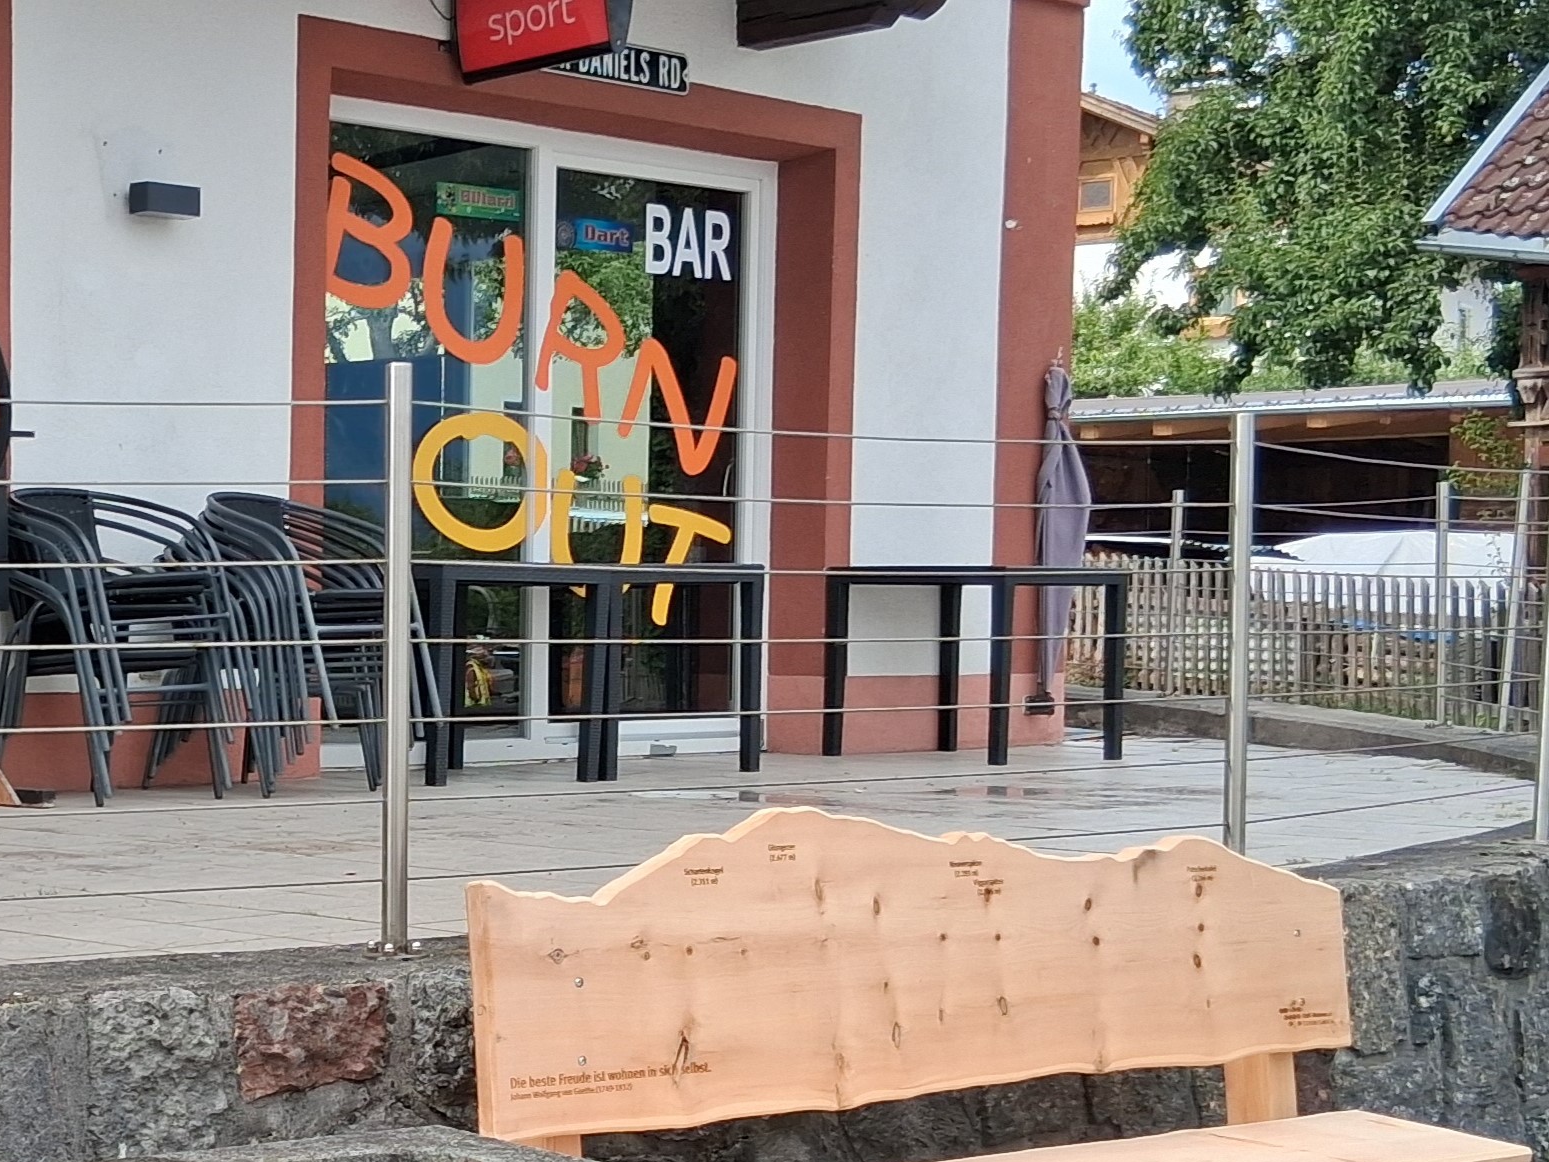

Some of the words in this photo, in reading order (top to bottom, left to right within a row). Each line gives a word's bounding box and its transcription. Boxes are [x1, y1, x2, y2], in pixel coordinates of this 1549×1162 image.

[488, 0, 576, 45] sport
[579, 49, 650, 83] DANIELS
[658, 55, 681, 89] RD
[460, 189, 516, 209] Billard
[583, 222, 631, 247] Dart
[645, 202, 732, 281] BAR
[326, 152, 737, 476] BURN
[413, 412, 731, 626] OUT
[510, 1076, 527, 1089] Die
[529, 1075, 557, 1087] beste
[558, 1072, 592, 1085] Freude
[593, 1070, 605, 1082] ist
[647, 1065, 657, 1078] in
